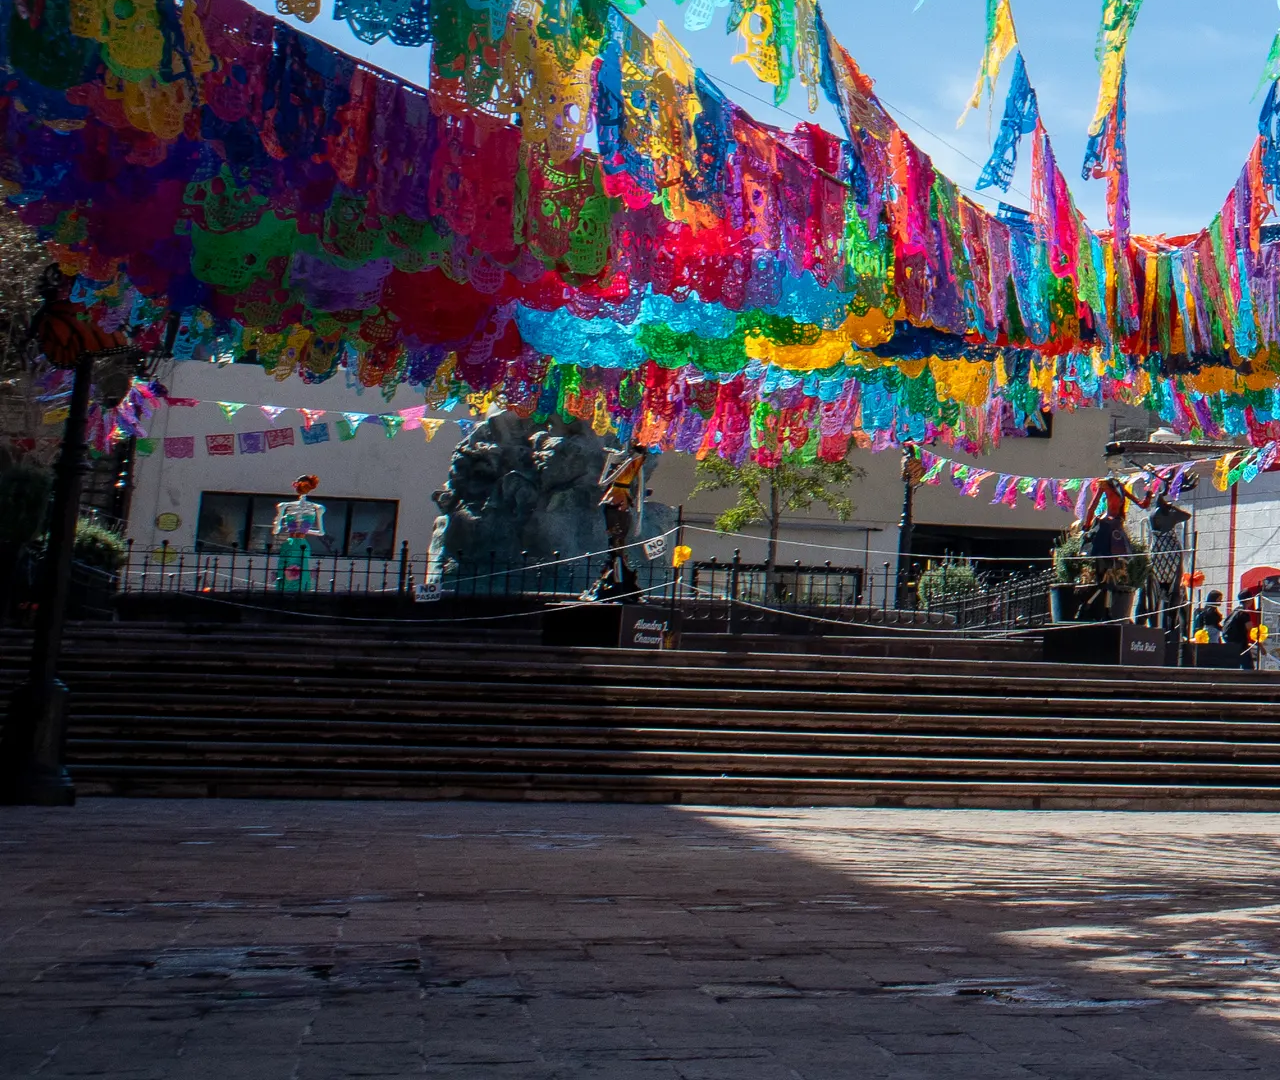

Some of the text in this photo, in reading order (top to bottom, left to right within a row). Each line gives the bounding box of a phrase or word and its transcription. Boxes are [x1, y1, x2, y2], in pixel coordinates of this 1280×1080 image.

[648, 538, 664, 551] NO
[420, 584, 437, 593] NO
[634, 632, 662, 644] Chavarr
